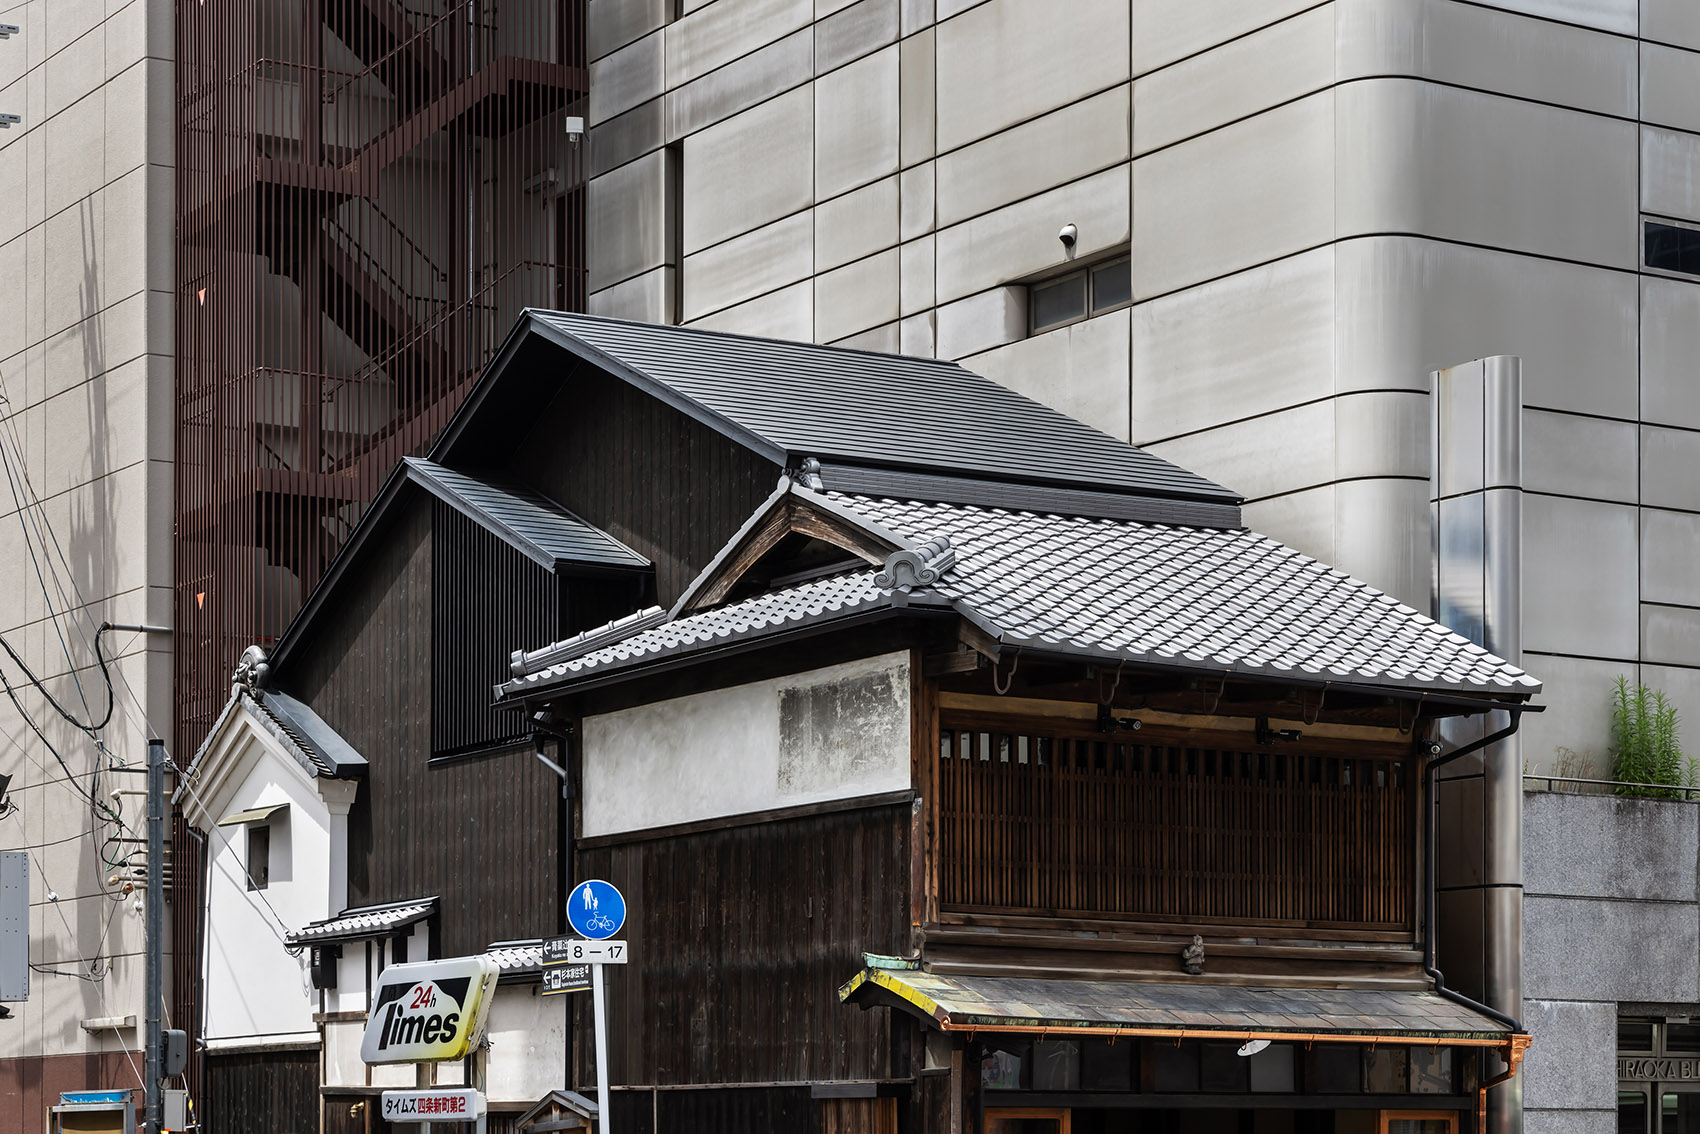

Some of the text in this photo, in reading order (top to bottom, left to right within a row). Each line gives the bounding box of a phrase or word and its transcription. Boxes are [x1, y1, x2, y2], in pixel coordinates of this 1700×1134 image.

[409, 985, 437, 1010] 24h
[378, 1002, 460, 1051] Times
[1681, 1061, 1700, 1079] BL
[385, 1096, 466, 1115] タイムズ四条新町第2
